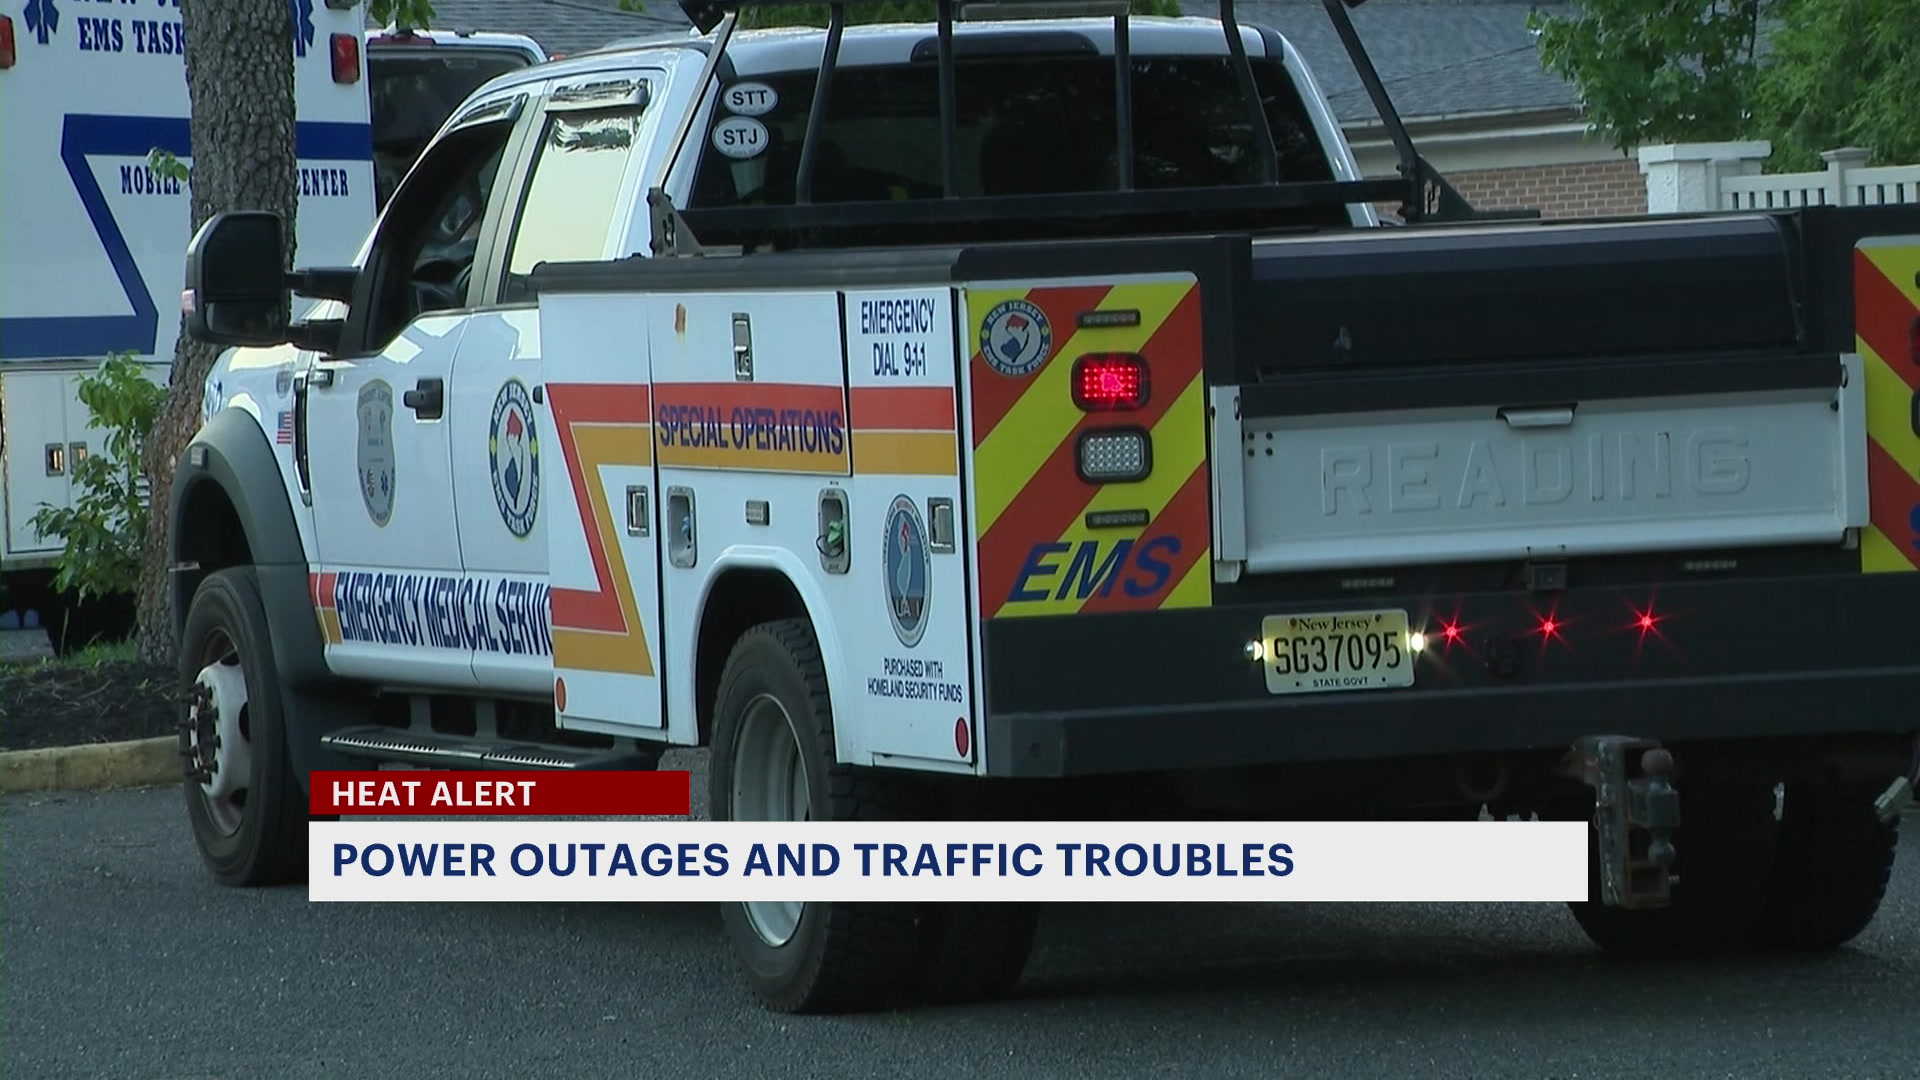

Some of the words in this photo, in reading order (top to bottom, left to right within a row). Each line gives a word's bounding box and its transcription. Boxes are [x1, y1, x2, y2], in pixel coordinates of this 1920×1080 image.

[77, 17, 124, 52] EMS
[732, 90, 768, 106] STT
[723, 128, 758, 145] STJ
[120, 165, 180, 195] MOBILE
[861, 298, 936, 334] EMERGENCY
[873, 342, 899, 376] DIAL
[659, 404, 728, 448] SPECIAL
[731, 406, 844, 455] OPERATIONS
[1320, 427, 1752, 516] READING
[1006, 535, 1182, 602] EMS
[336, 571, 425, 646] EMERGENCY
[423, 576, 499, 652] MEDICAL
[1299, 618, 1330, 631] New
[1331, 616, 1371, 632] Jersey
[884, 658, 924, 677] PURCHASED
[925, 660, 943, 679] WITH
[1273, 631, 1400, 674] SG37095
[867, 677, 904, 698] HOMELAND
[905, 680, 938, 700] SECURITY
[938, 683, 963, 703] FUNDS
[1313, 678, 1339, 688] STATE
[1343, 677, 1369, 686] GOVT
